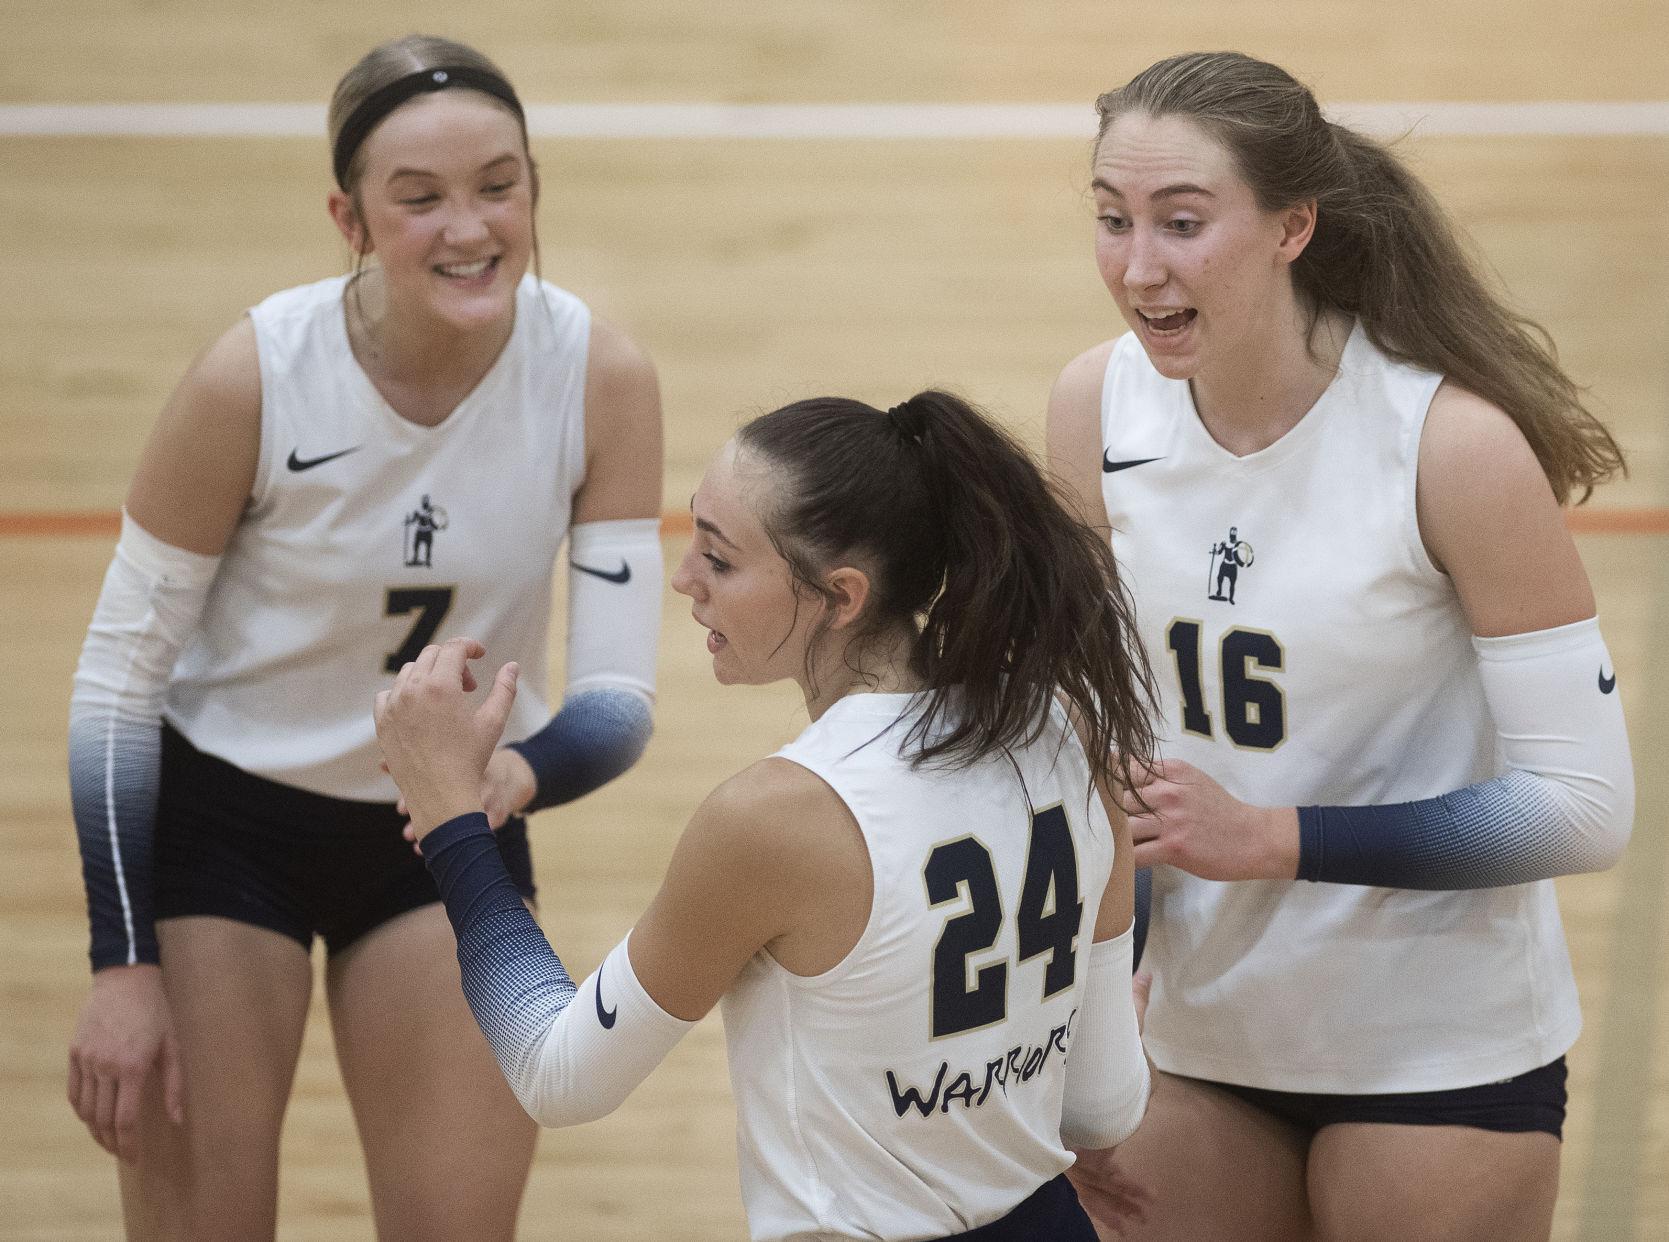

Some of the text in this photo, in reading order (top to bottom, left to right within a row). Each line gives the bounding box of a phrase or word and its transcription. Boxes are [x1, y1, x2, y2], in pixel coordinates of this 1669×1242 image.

[384, 583, 456, 674] 7
[1165, 616, 1288, 753] 16
[922, 800, 1086, 1042] 24
